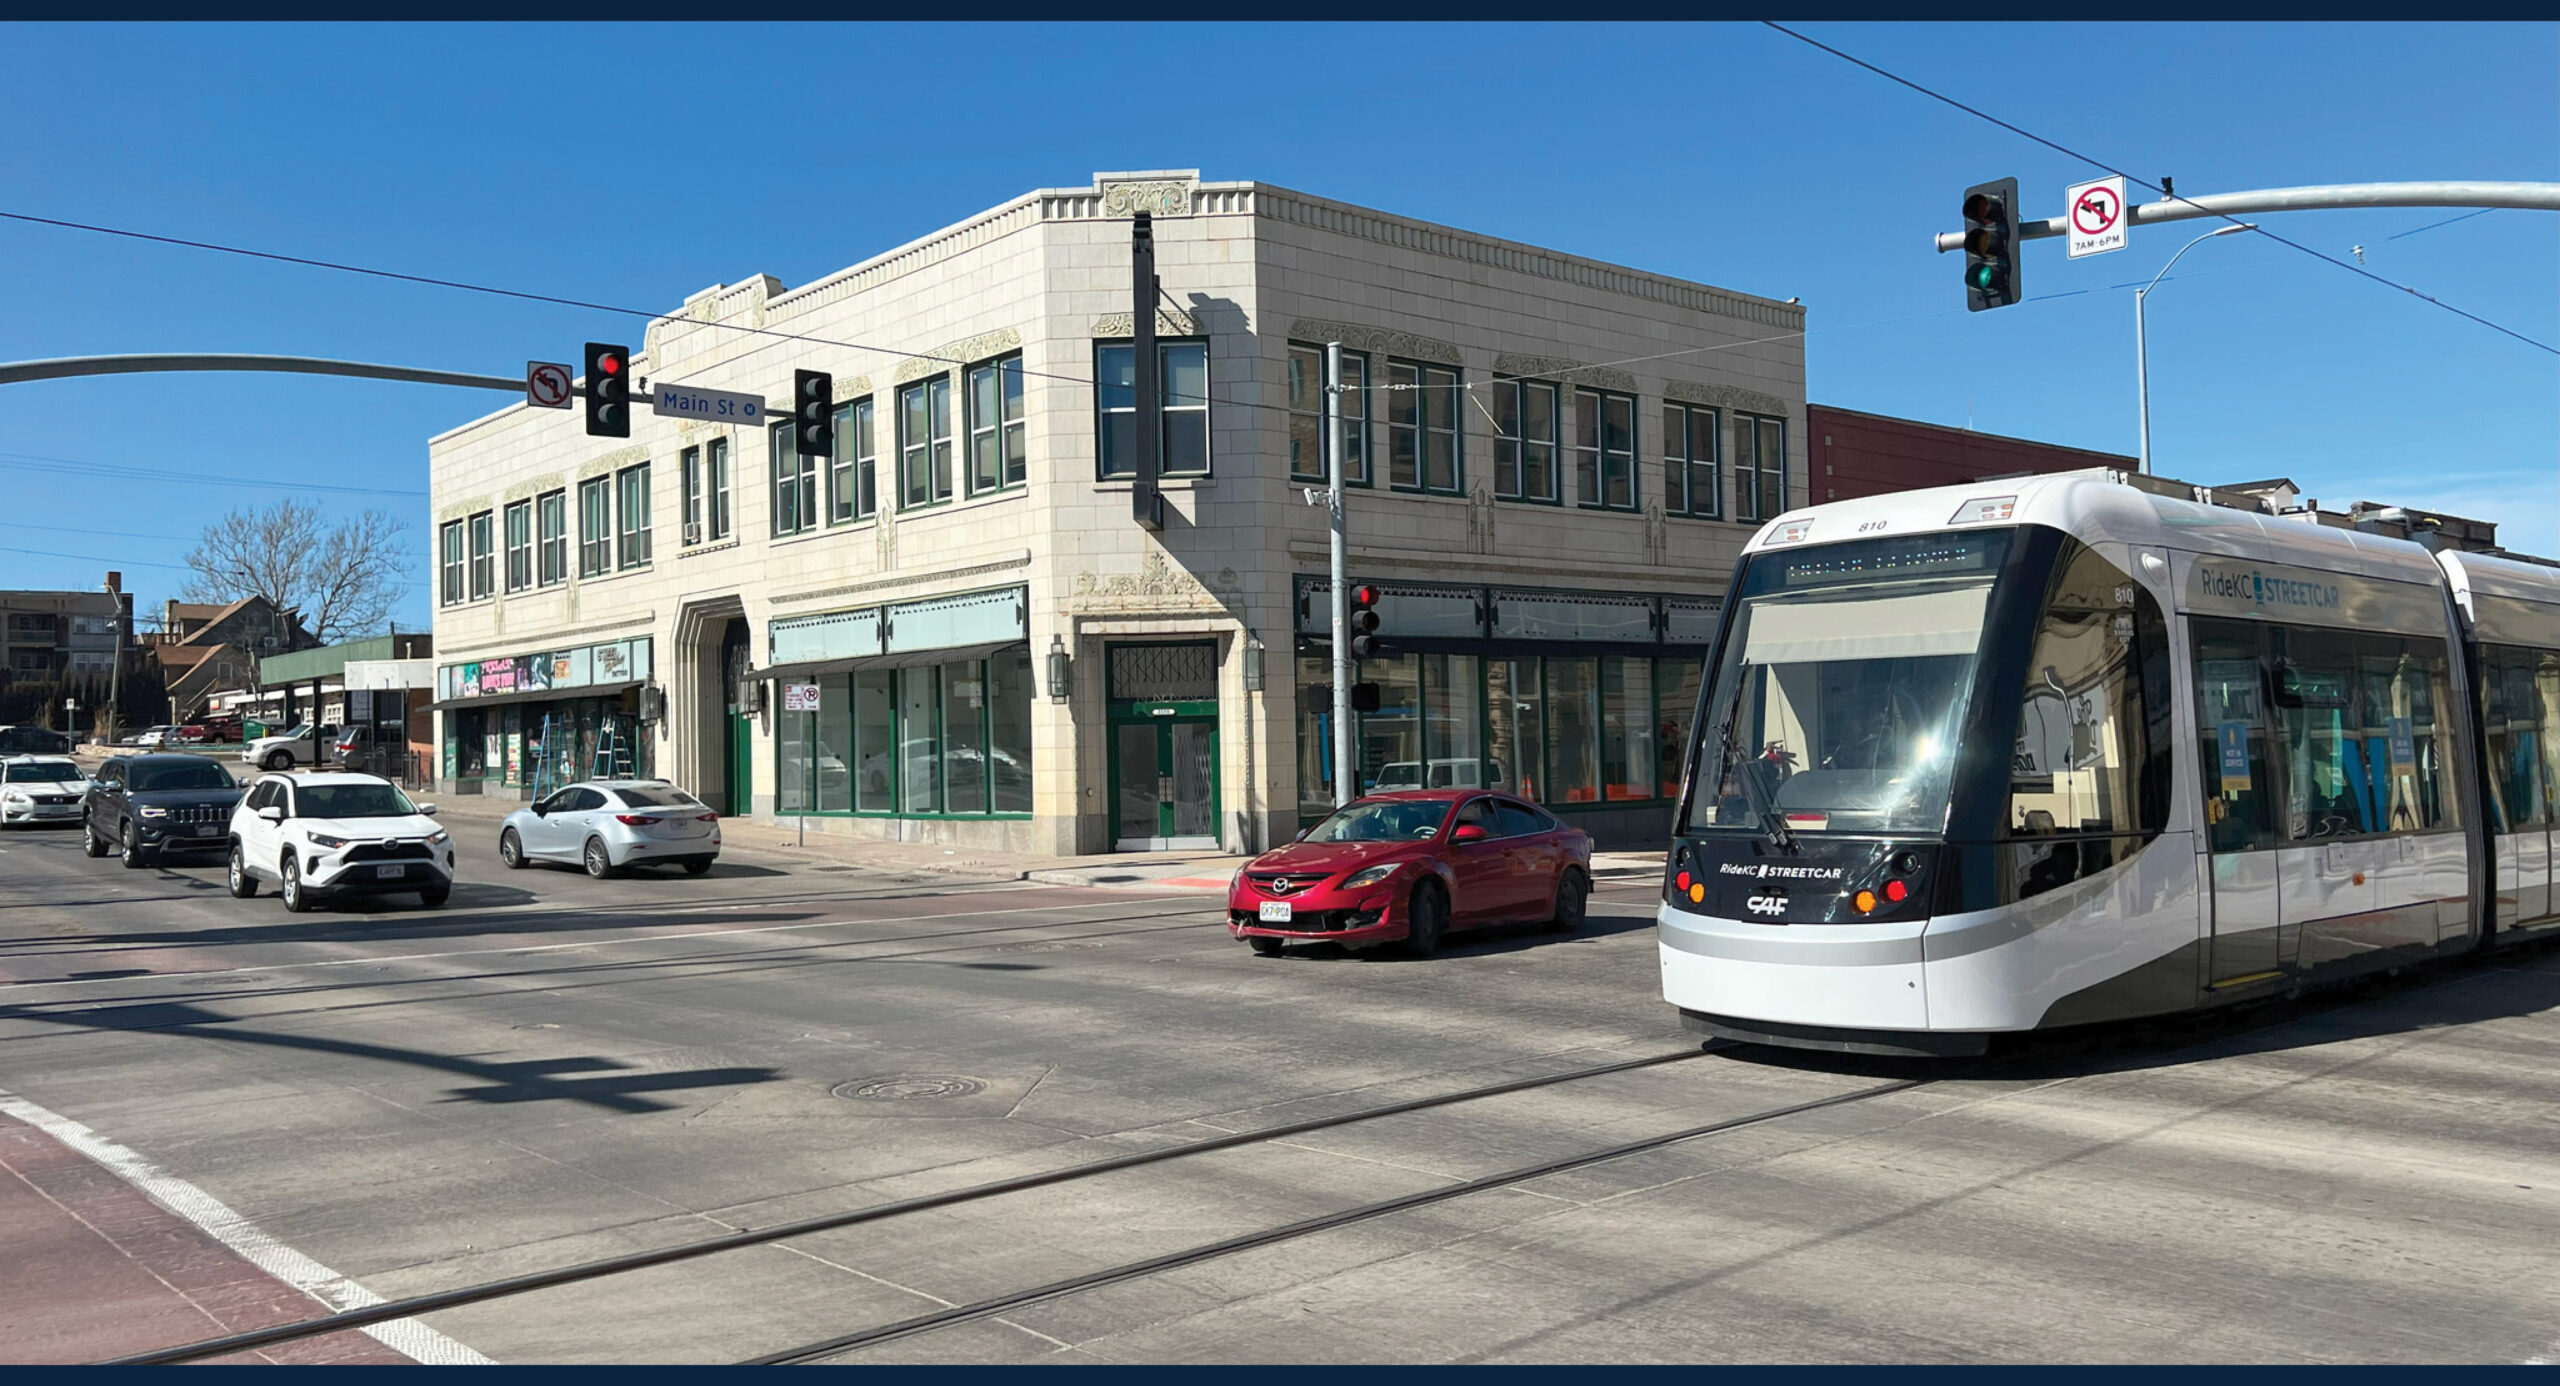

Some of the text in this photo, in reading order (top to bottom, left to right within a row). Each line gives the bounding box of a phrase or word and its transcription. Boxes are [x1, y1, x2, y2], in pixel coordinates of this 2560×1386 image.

[664, 392, 734, 416] Main St
[1859, 520, 1887, 532] 810
[2115, 587, 2134, 602] 810
[2201, 569, 2339, 608] RideKC STREETCAR
[1720, 863, 1841, 878] RideKC STREETCAR
[1747, 896, 1789, 916] CAF
